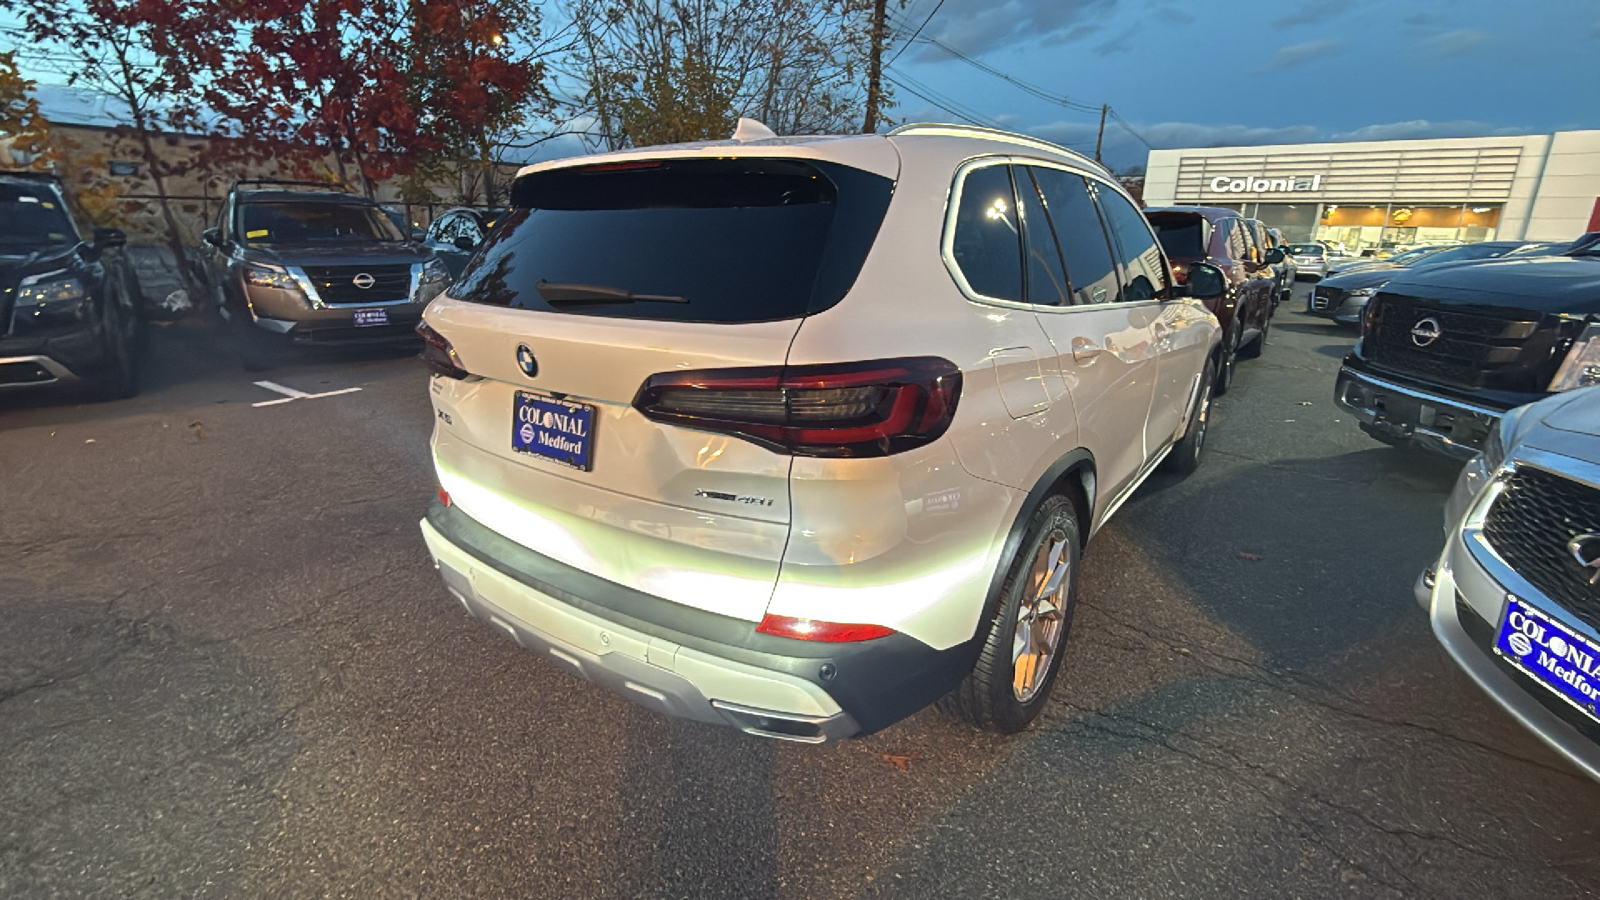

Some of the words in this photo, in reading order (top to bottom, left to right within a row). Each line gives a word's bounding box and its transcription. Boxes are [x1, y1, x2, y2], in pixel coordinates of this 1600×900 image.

[1210, 174, 1321, 193] Colonial
[519, 405, 587, 437] COLONIAL
[538, 430, 582, 454] Medford
